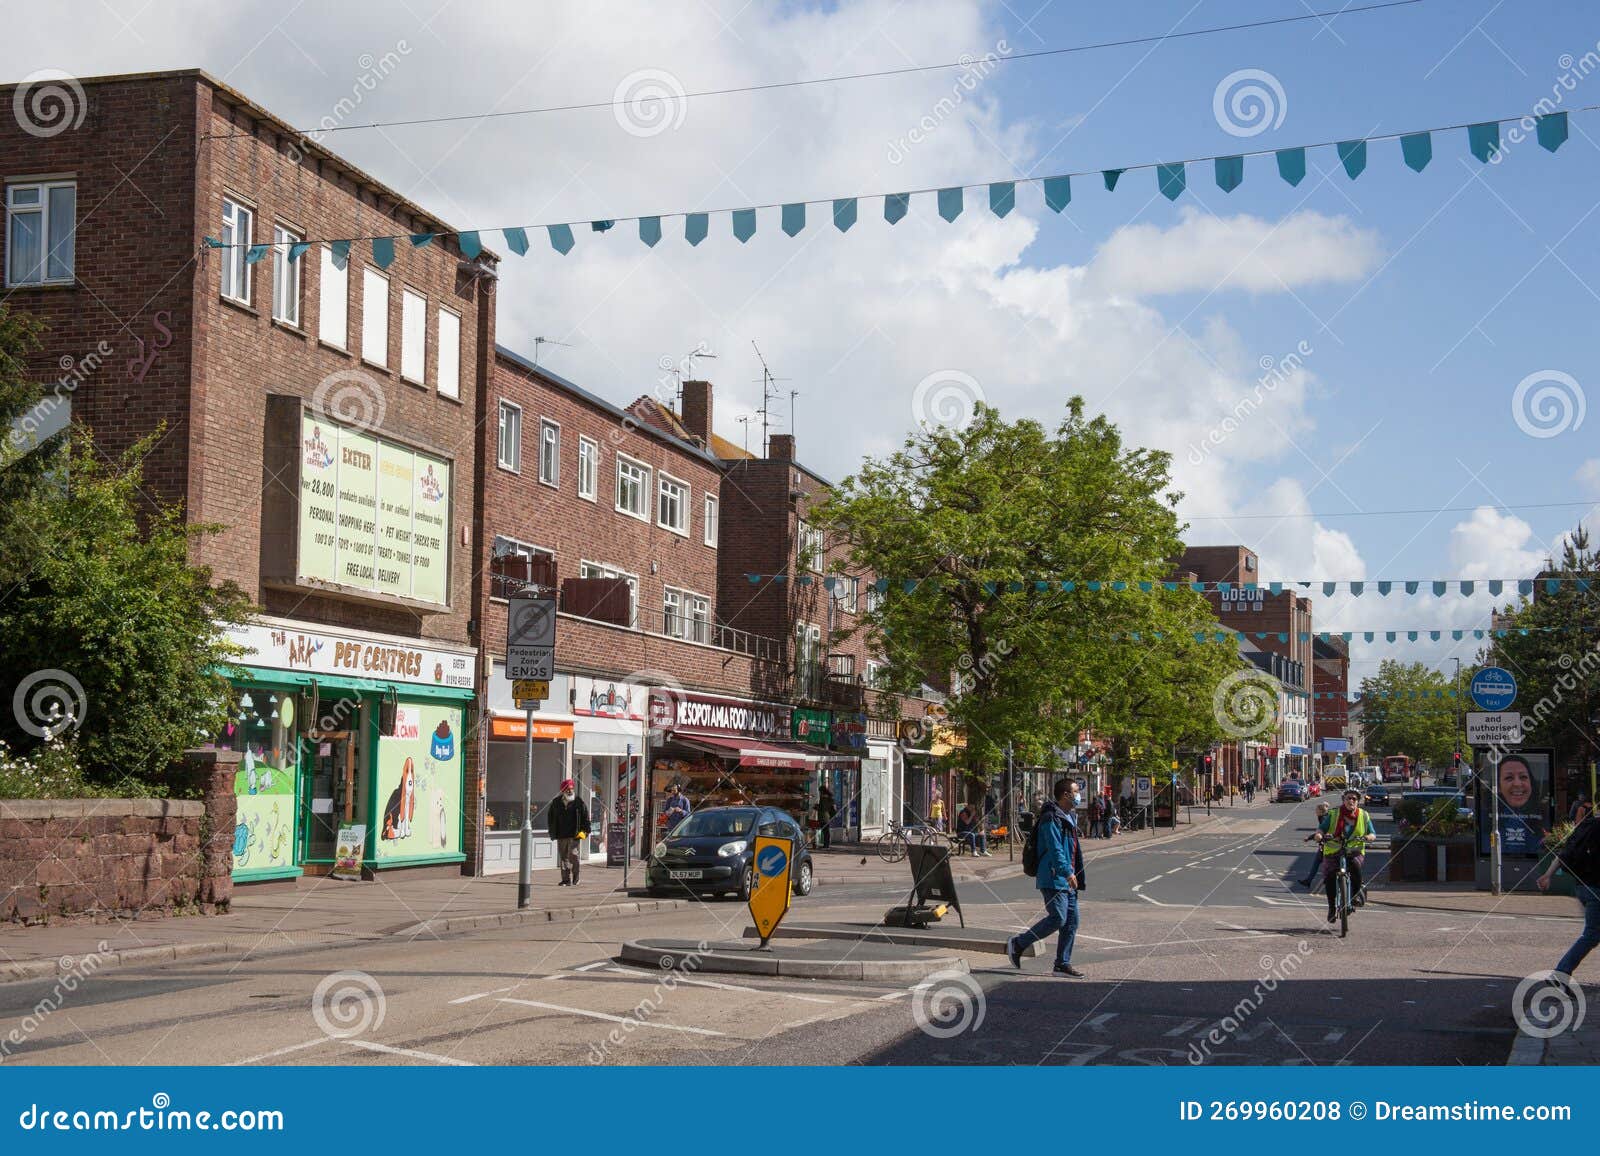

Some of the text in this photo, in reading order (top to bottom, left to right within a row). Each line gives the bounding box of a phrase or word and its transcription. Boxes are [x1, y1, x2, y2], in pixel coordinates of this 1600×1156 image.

[342, 446, 372, 472] EXETER
[312, 478, 334, 499] 28,800
[309, 506, 334, 524] PERSONAL
[338, 513, 362, 531] SHOPPING
[362, 520, 376, 534] HERE
[386, 526, 394, 538] PET
[396, 528, 412, 542] WEIGHT
[430, 537, 440, 550] FREE
[328, 536, 334, 547] OF
[378, 546, 392, 560] TREATS
[420, 556, 430, 568] FOOD
[346, 562, 400, 584] FREE LOCAL DELIVERY
[1222, 588, 1264, 601] ODEON
[270, 630, 423, 678] THE ARK PET CENTRES
[510, 648, 551, 657] Pedestrian
[520, 657, 540, 665] Zone
[512, 666, 548, 677] ENDS
[677, 701, 730, 728] MESOPOTAMIA
[730, 708, 748, 730] FOOD
[748, 710, 774, 732] BAZAAR
[1470, 724, 1518, 732] authorised
